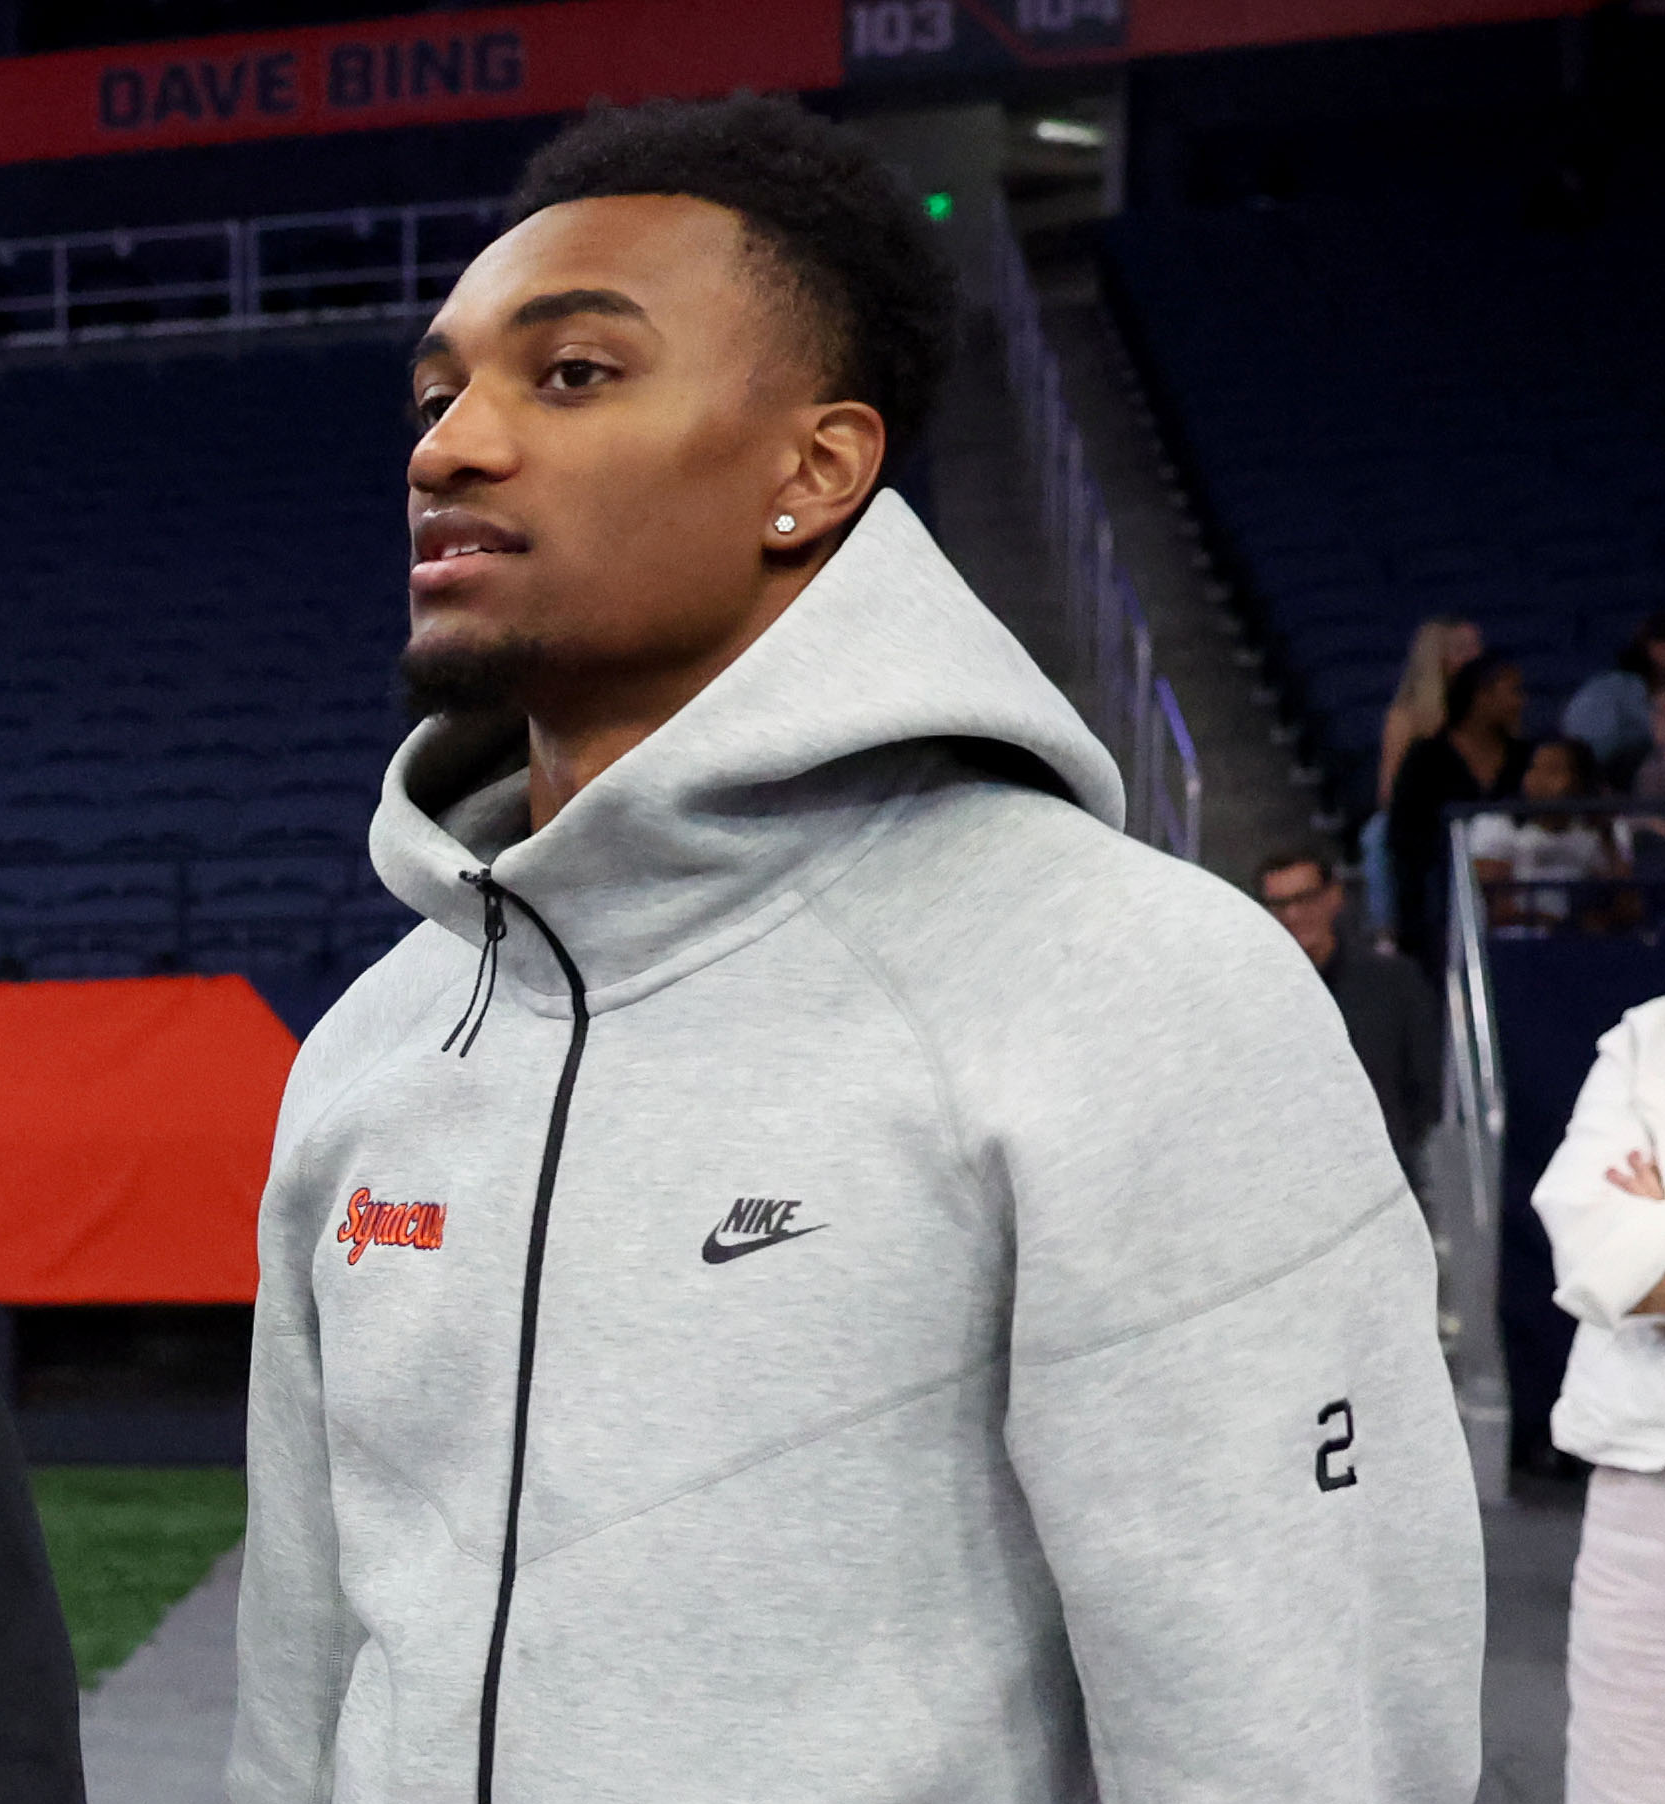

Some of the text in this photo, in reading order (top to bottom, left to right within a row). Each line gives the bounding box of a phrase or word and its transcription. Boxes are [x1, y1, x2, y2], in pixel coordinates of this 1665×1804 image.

[852, 3, 953, 56] 103
[98, 30, 525, 130] DAVE BING
[720, 1198, 802, 1235] NIKE
[1315, 1398, 1357, 1493] 2
